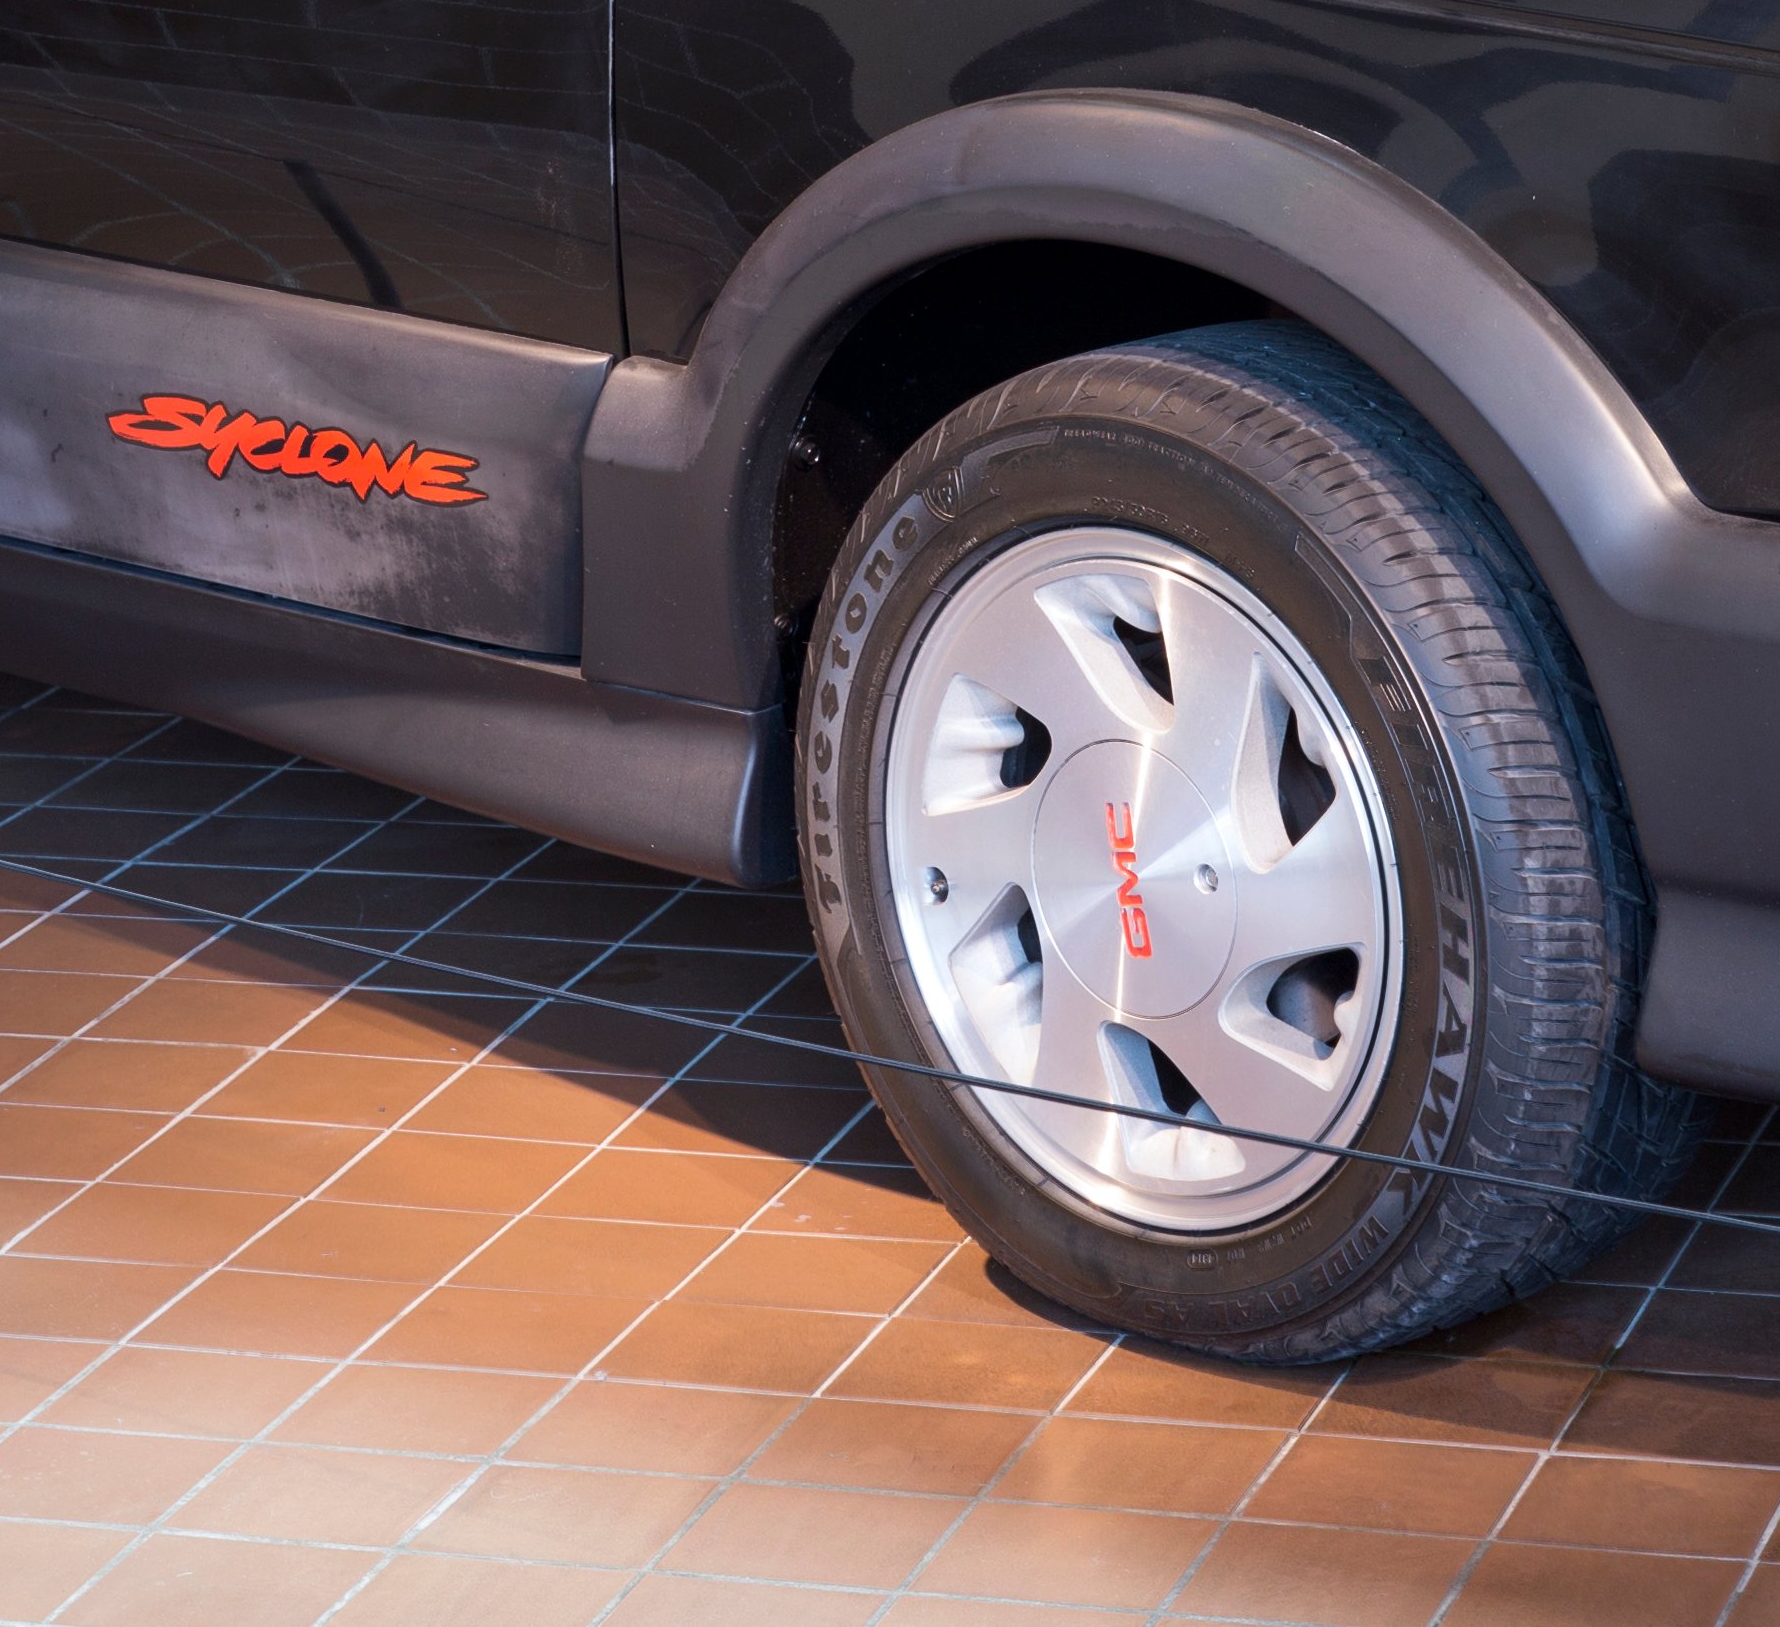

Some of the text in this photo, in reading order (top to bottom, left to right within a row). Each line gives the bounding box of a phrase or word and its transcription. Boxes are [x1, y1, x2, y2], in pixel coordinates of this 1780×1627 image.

[106, 393, 491, 507] SYCLONE
[812, 515, 919, 915] Firestone
[1105, 801, 1153, 959] GMC
[1357, 655, 1471, 1216] FIREHAWK
[1208, 1279, 1303, 1327] OVAL
[1312, 1214, 1390, 1289] WIDE
